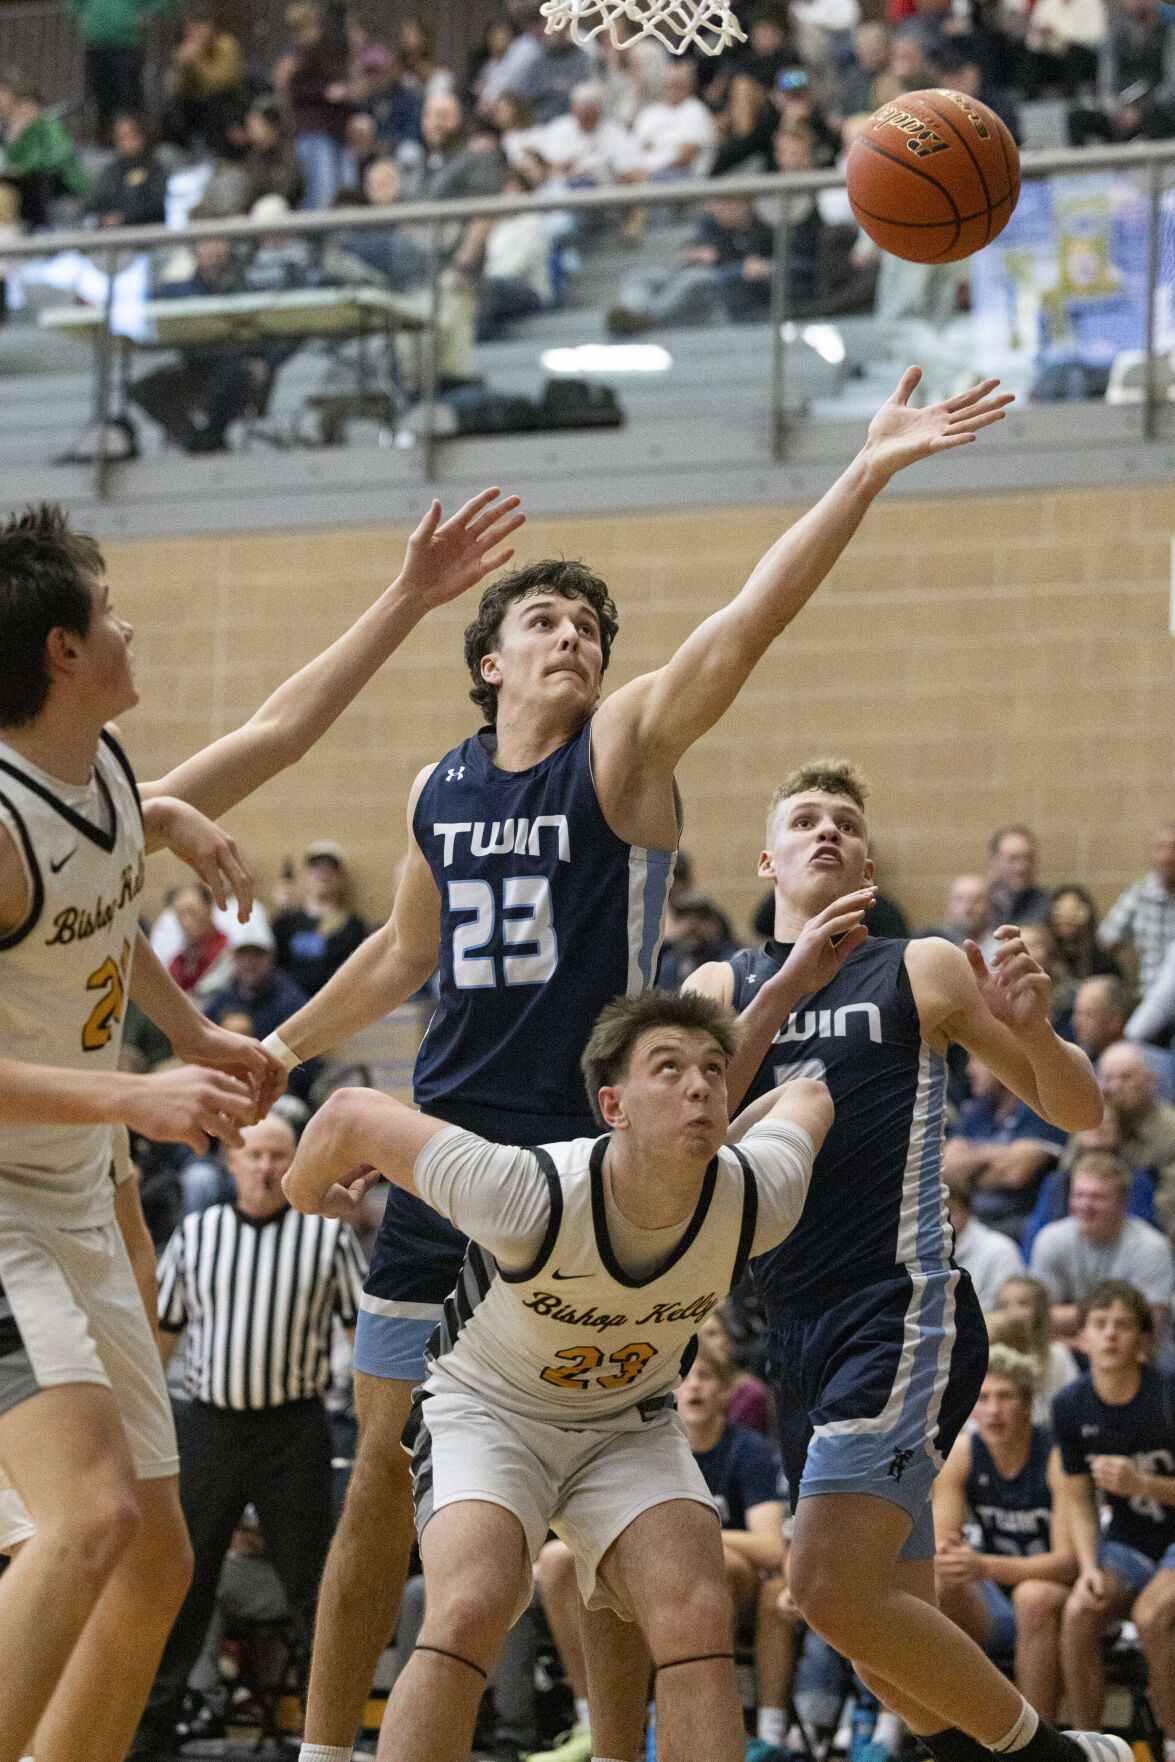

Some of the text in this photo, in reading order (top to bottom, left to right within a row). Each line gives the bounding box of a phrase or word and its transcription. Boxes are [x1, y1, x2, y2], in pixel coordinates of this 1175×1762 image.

[867, 106, 951, 158] Bad
[433, 814, 571, 868] TWIN
[447, 875, 558, 990] 23
[771, 1002, 883, 1044] WIN
[522, 1291, 719, 1333] Bishop Kelly
[539, 1342, 658, 1390] 23
